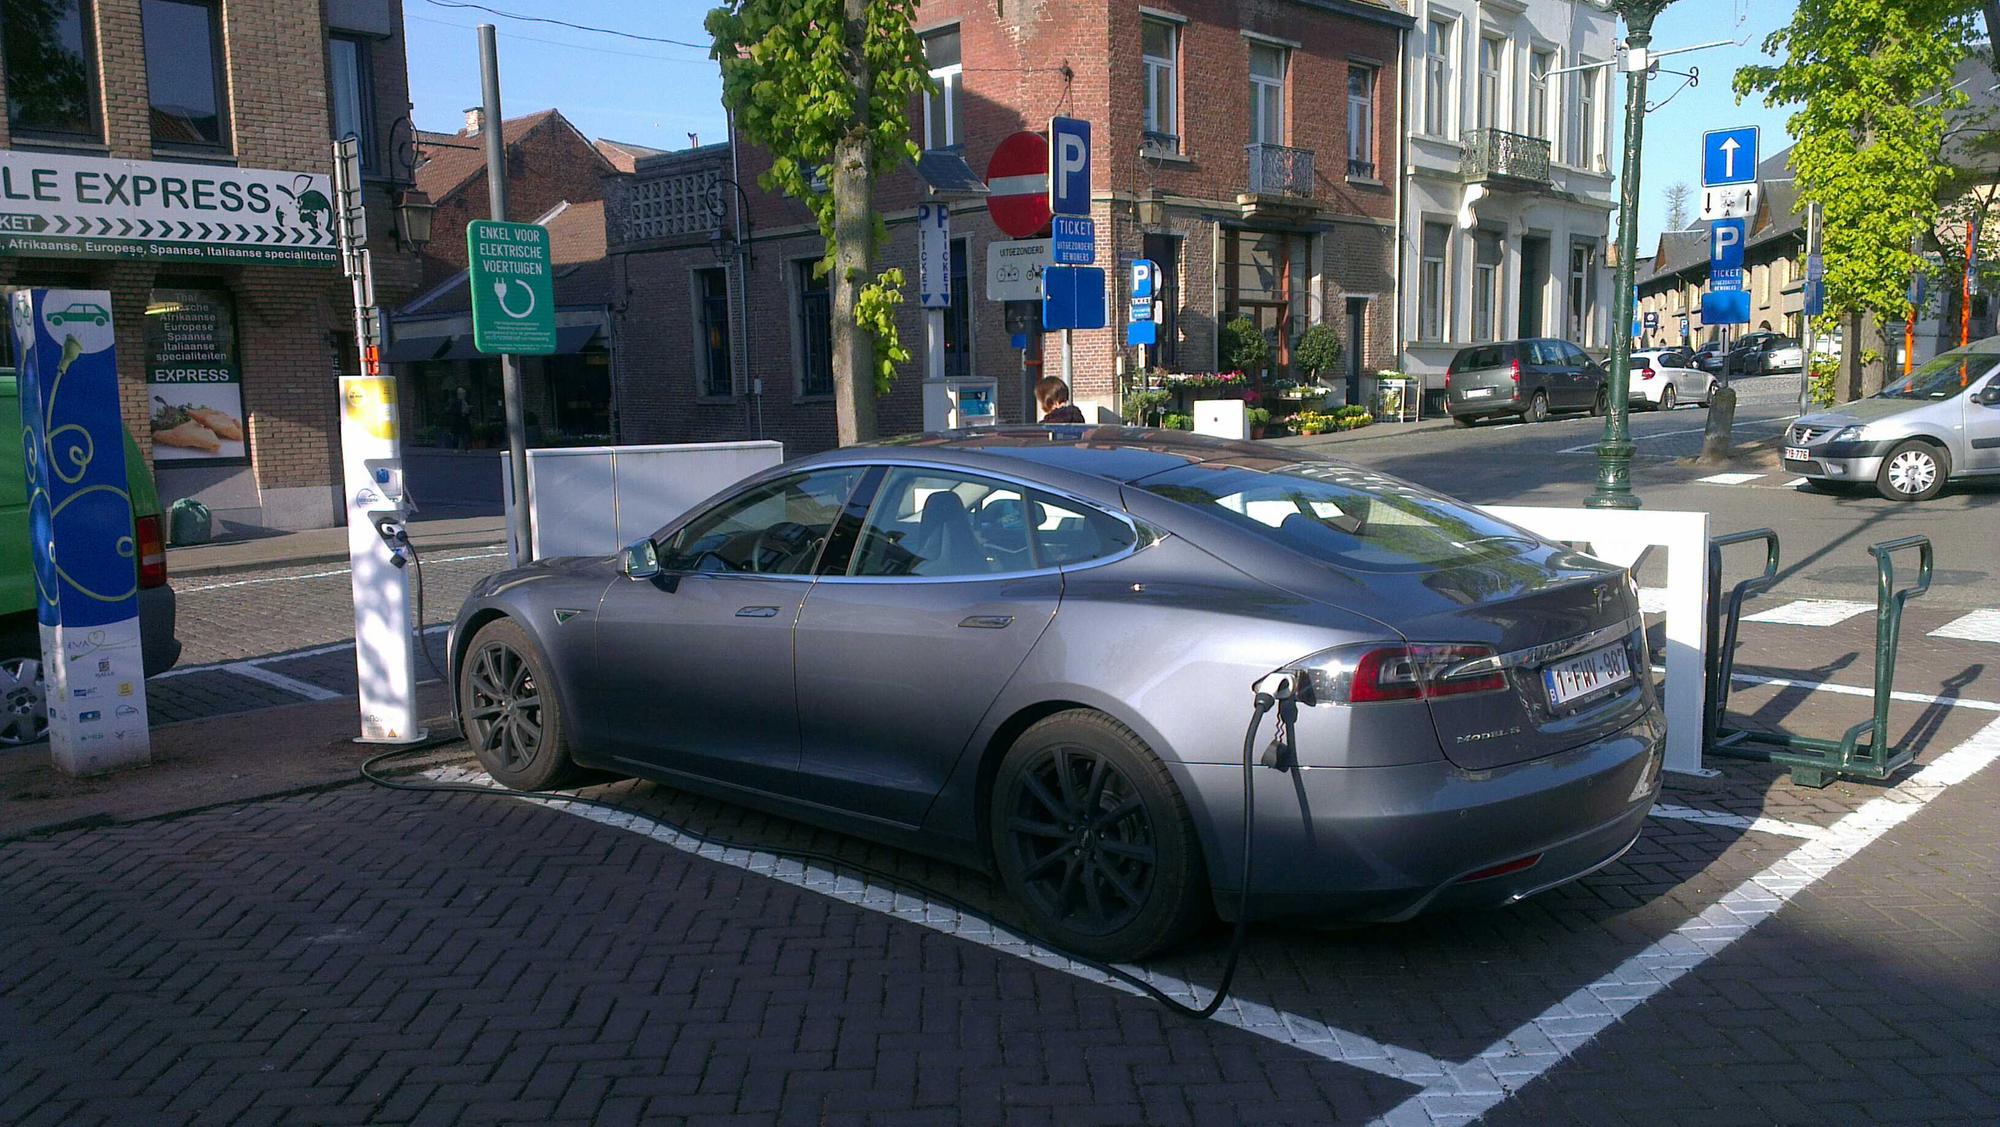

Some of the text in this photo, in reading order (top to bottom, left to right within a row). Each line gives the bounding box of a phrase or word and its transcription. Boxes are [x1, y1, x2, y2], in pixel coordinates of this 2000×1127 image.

[1058, 132, 1086, 199] P
[0, 166, 271, 214] LE EXPRESS
[937, 204, 949, 228] P
[480, 226, 540, 242] ENKEL VOOR
[1059, 220, 1092, 236] TICKET
[9, 239, 82, 252] Afrikaanse,
[86, 242, 147, 256] Europese,
[150, 244, 204, 257] Spaanse,
[207, 246, 262, 258] Italiaanse
[264, 250, 337, 262] specialiteiten
[480, 243, 543, 259] ELEKTRISCHE
[1715, 226, 1739, 260] P
[483, 260, 542, 275] VOERTUIGEN
[1713, 269, 1740, 278] TICKET
[1133, 265, 1149, 291] P
[164, 322, 214, 332] Europese
[167, 332, 213, 342] Spaanse
[163, 342, 215, 351] Italiaanse
[156, 352, 227, 361] specialiteiten
[155, 369, 229, 382] EXPRESS
